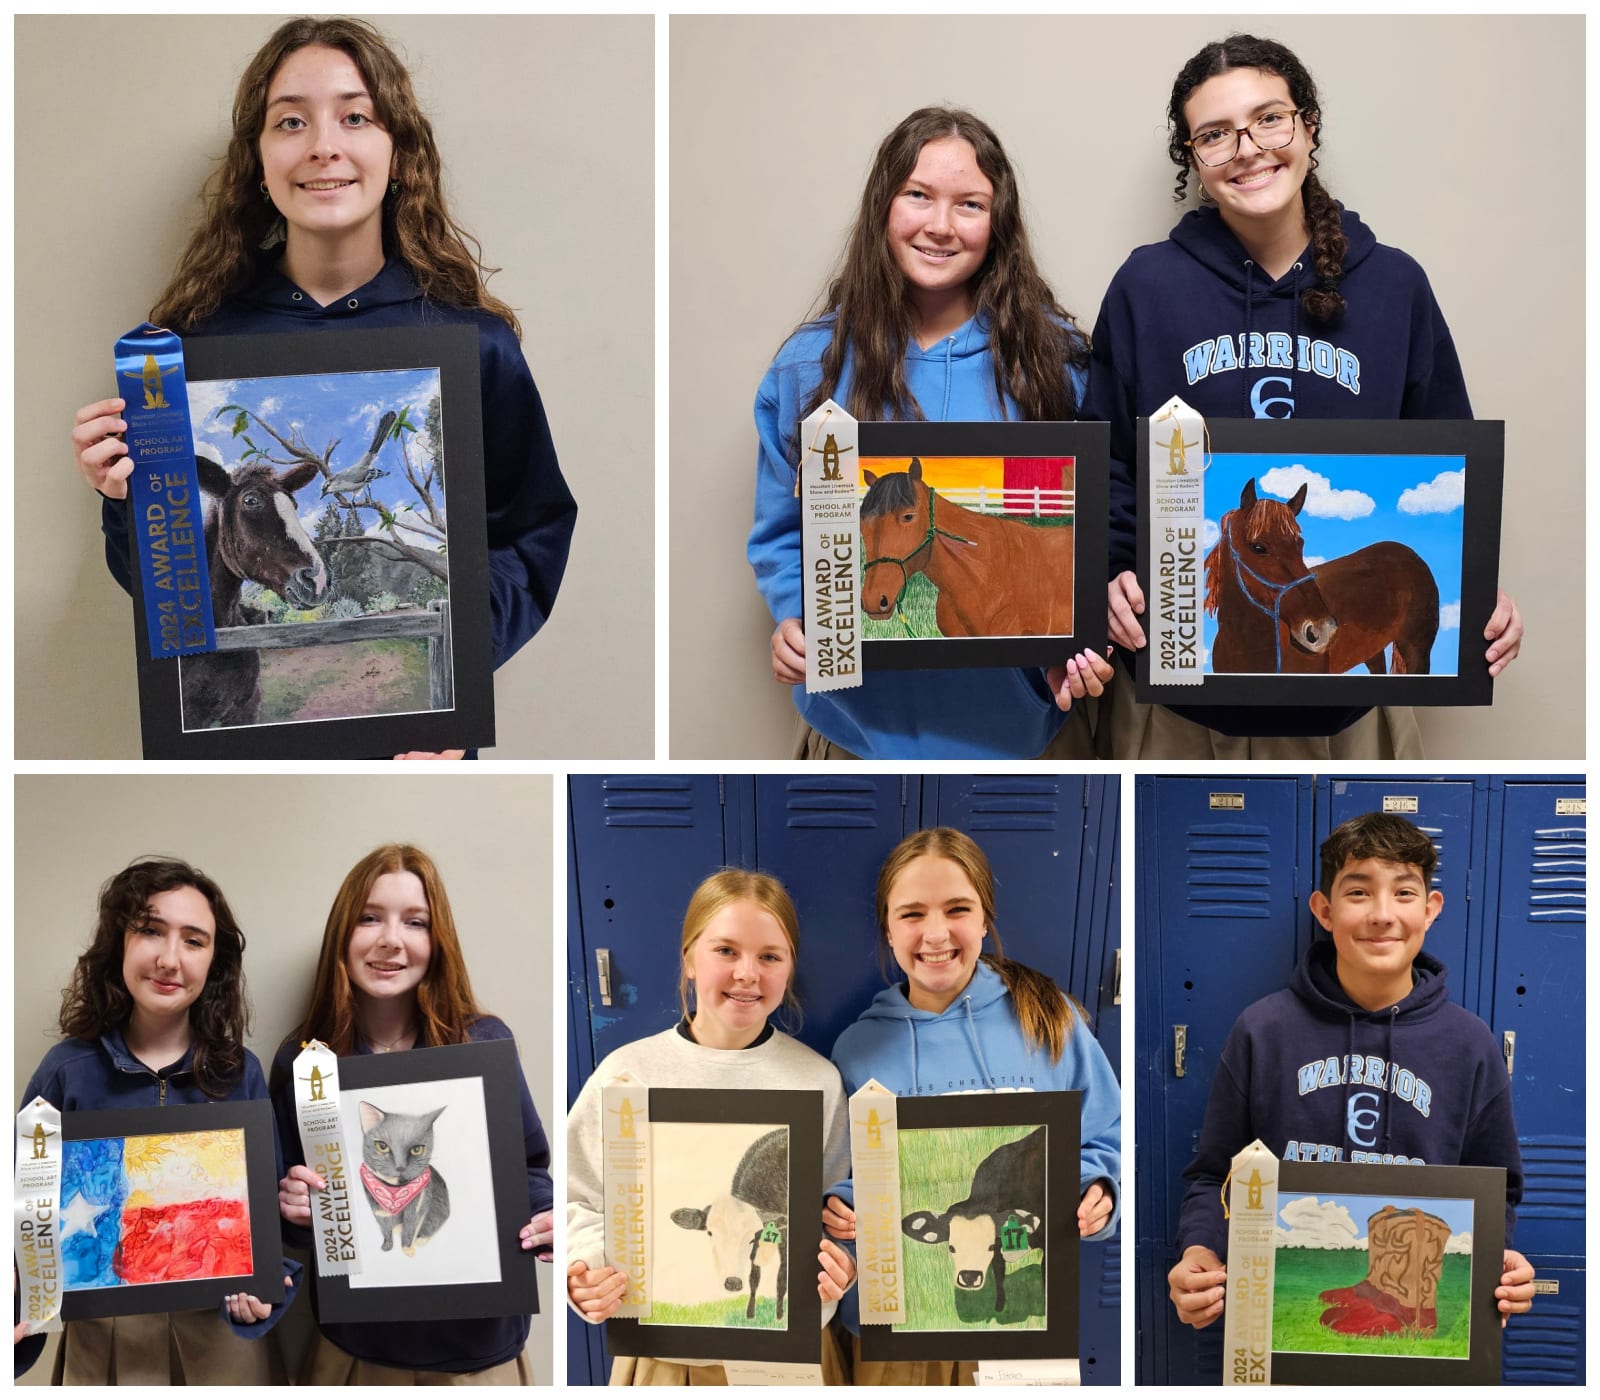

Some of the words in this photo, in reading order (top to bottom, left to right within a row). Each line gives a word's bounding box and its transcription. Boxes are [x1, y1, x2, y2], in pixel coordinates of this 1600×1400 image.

[1183, 332, 1360, 395] WARRIOR
[134, 437, 169, 446] SCHOOL
[140, 446, 184, 456] PROGRAM
[149, 473, 163, 492] OF
[147, 504, 174, 591] AWARD
[165, 472, 207, 647] EXCELLENCE
[820, 533, 830, 549] OF
[1165, 527, 1175, 543] OF
[815, 559, 832, 629] AWARD
[833, 533, 856, 675] EXCELLENCE
[1160, 552, 1175, 622] AWARD
[1178, 527, 1196, 669] EXCELLENCE
[158, 600, 181, 650] 2024
[1160, 629, 1176, 670] 2024
[817, 637, 834, 678] 2024
[948, 1076, 1035, 1088] CHRISTIAN
[1298, 1054, 1432, 1118] WARRIOR
[307, 1124, 337, 1132] PROGRAM
[325, 1142, 356, 1261] EXCELLENCE
[20, 1220, 40, 1278] AWARD
[36, 1198, 57, 1320] EXCELLENCE
[323, 1228, 339, 1263] 2024
[613, 1203, 627, 1265] AWARD
[628, 1183, 646, 1306] EXCELLENCE
[764, 1231, 779, 1243] 17
[877, 1192, 899, 1312] EXCELLENCE
[1004, 1228, 1025, 1249] 17
[28, 1284, 41, 1320] 2024
[1250, 1256, 1269, 1384] EXCELLENCE
[1234, 1348, 1248, 1383] 2024
